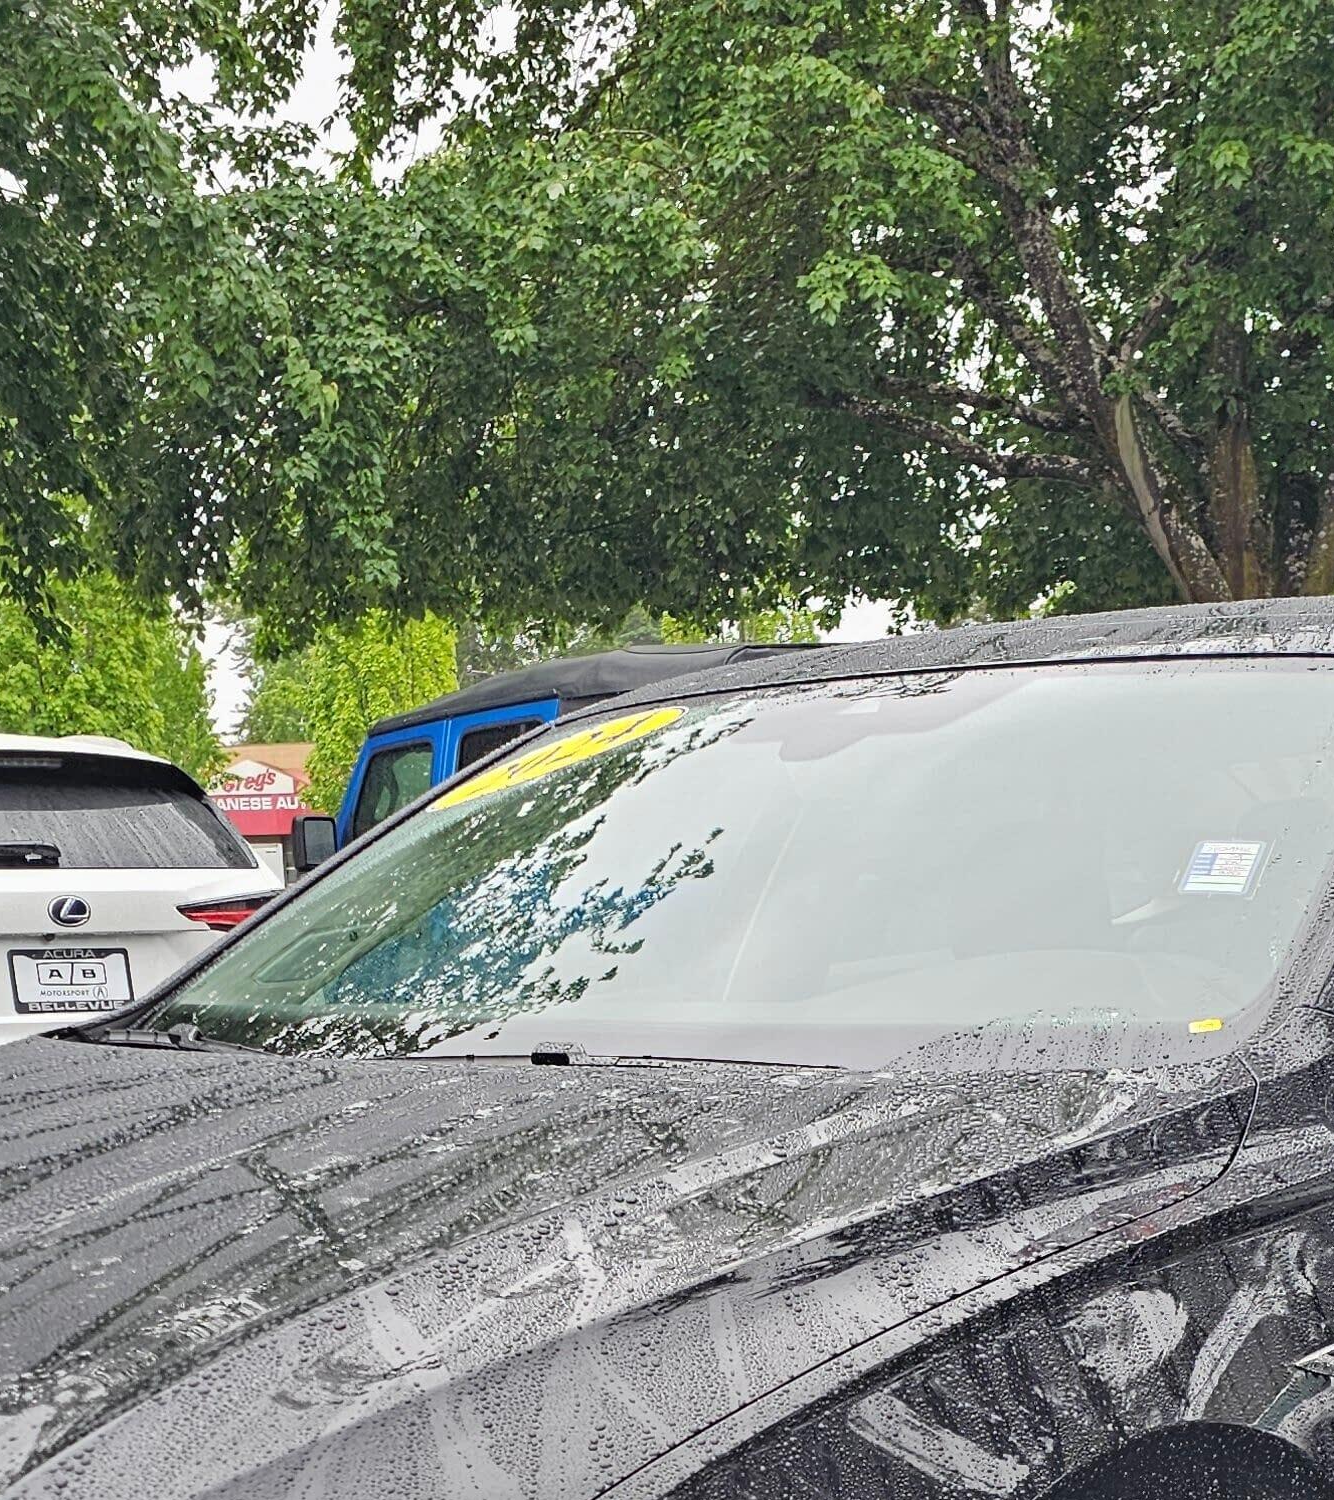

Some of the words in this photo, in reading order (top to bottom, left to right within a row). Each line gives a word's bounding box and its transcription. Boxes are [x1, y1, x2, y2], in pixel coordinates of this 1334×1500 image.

[214, 797, 272, 811] ANESE
[42, 949, 95, 959] ACURA
[48, 969, 63, 979] A
[81, 968, 96, 978] B
[40, 989, 89, 997] MOTORSPORT
[28, 1000, 125, 1012] BELLEVUE
